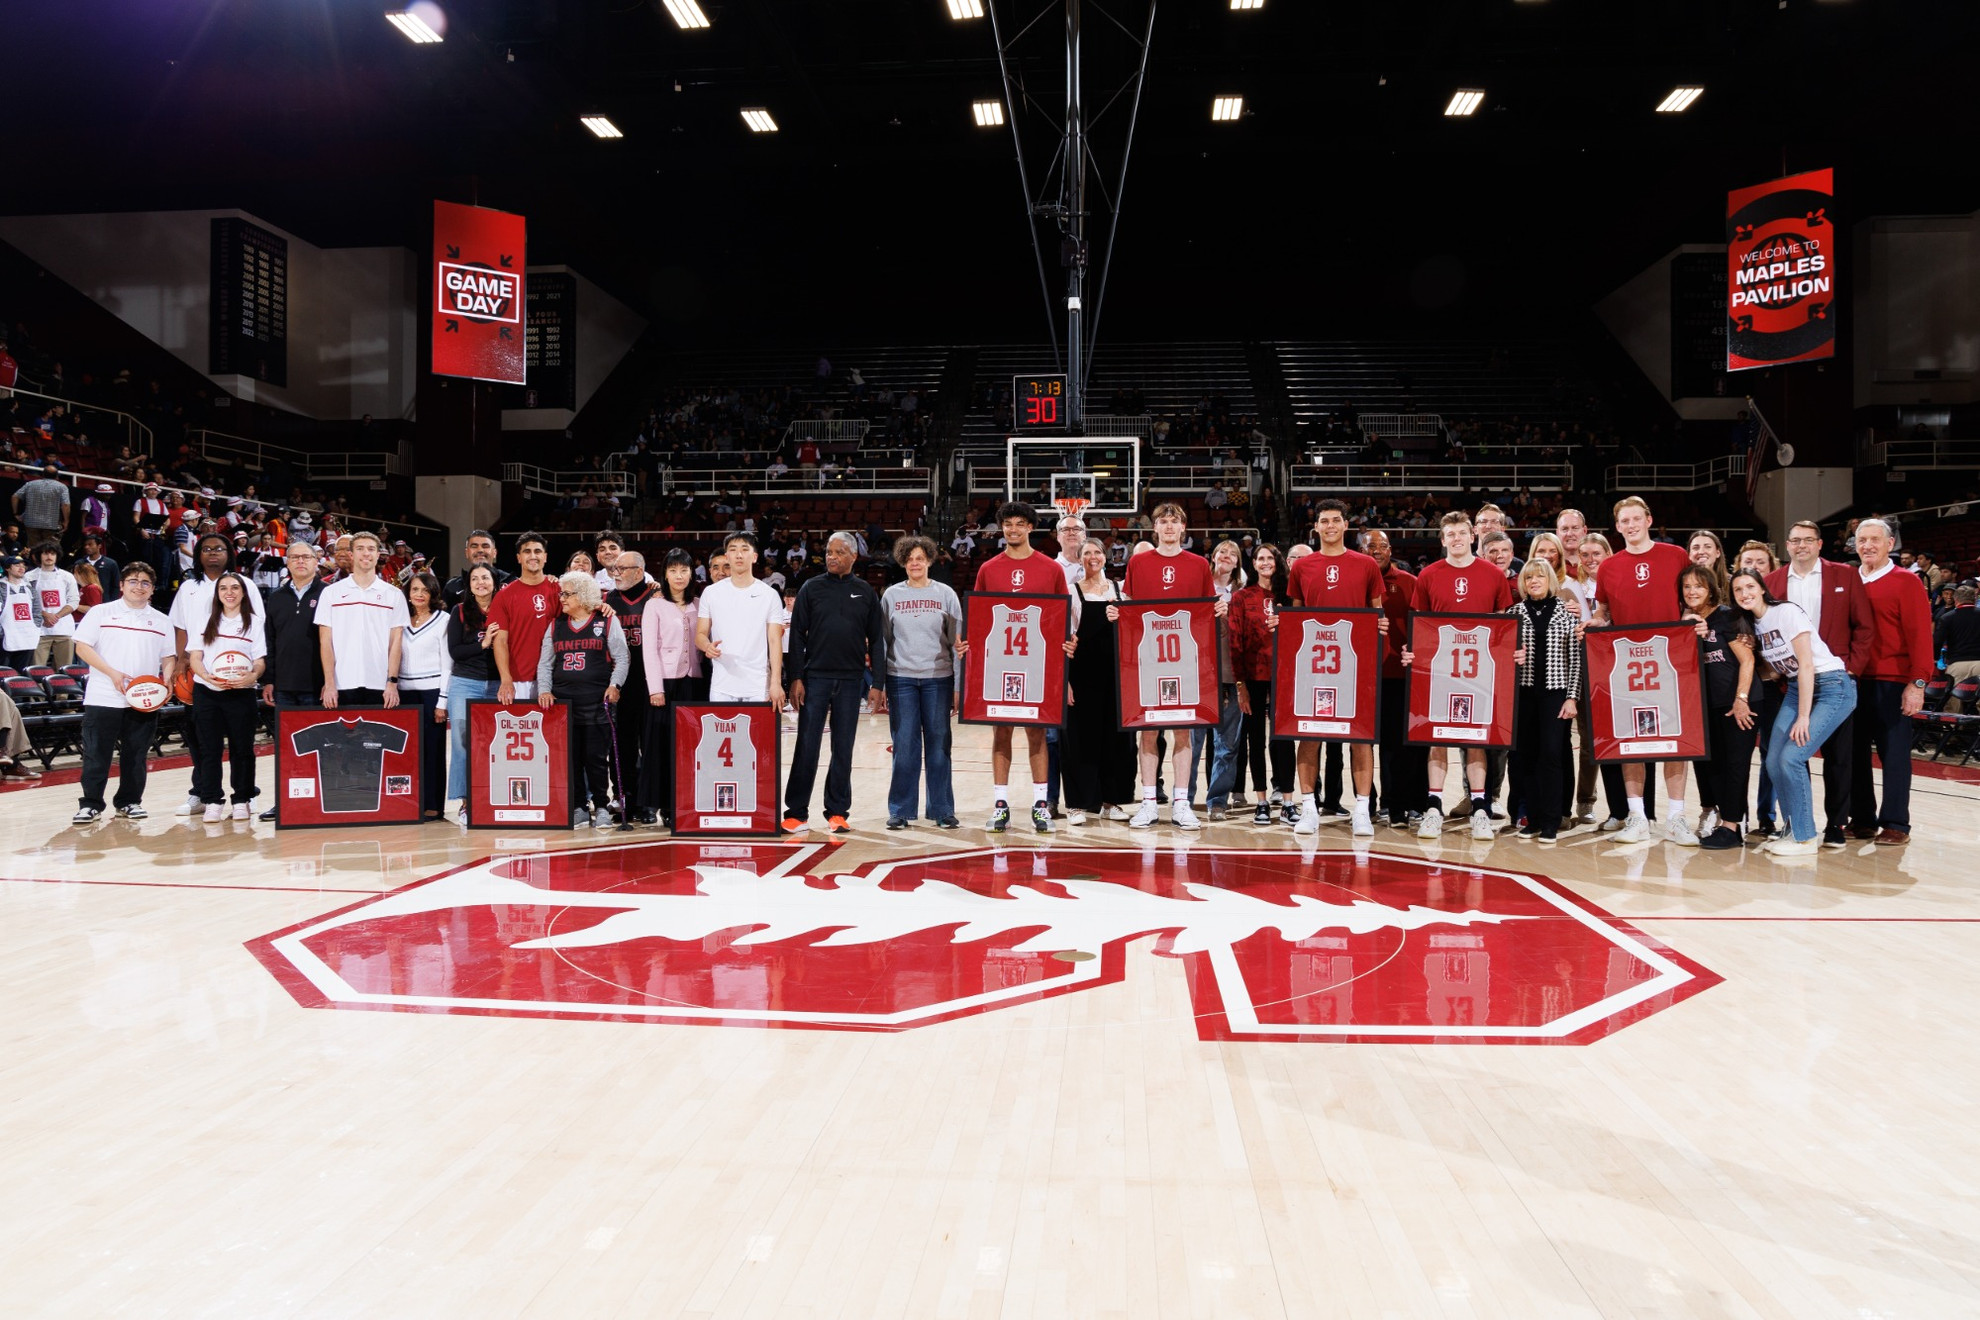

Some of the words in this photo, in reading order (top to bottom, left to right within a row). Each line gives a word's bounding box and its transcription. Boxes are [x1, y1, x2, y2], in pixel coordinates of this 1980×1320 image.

[1740, 243, 1800, 263] WELCOME
[1803, 239, 1820, 251] TO
[1736, 254, 1825, 285] MAPLES
[446, 272, 513, 298] GAME
[1732, 276, 1830, 308] PAVILION
[457, 292, 502, 315] DAY
[1030, 381, 1061, 395] 7:13
[1026, 397, 1056, 423] 30
[895, 599, 942, 611] STANFORD
[1006, 612, 1028, 623] JONES
[1151, 619, 1182, 631] MURRELL
[553, 638, 603, 653] TANFORD
[1003, 626, 1029, 656] 14
[1315, 630, 1338, 642] ANGEL
[1452, 633, 1478, 645] JONES
[1156, 633, 1181, 663] 10
[1312, 644, 1341, 674] 23
[1629, 645, 1654, 658] KEEFE
[563, 652, 586, 671] 25
[1450, 648, 1479, 679] 13
[1627, 660, 1661, 692] 22
[501, 719, 539, 730] GIL-SILVA
[714, 722, 737, 733] YUAN
[506, 731, 534, 761] 25
[717, 737, 734, 767] 4
